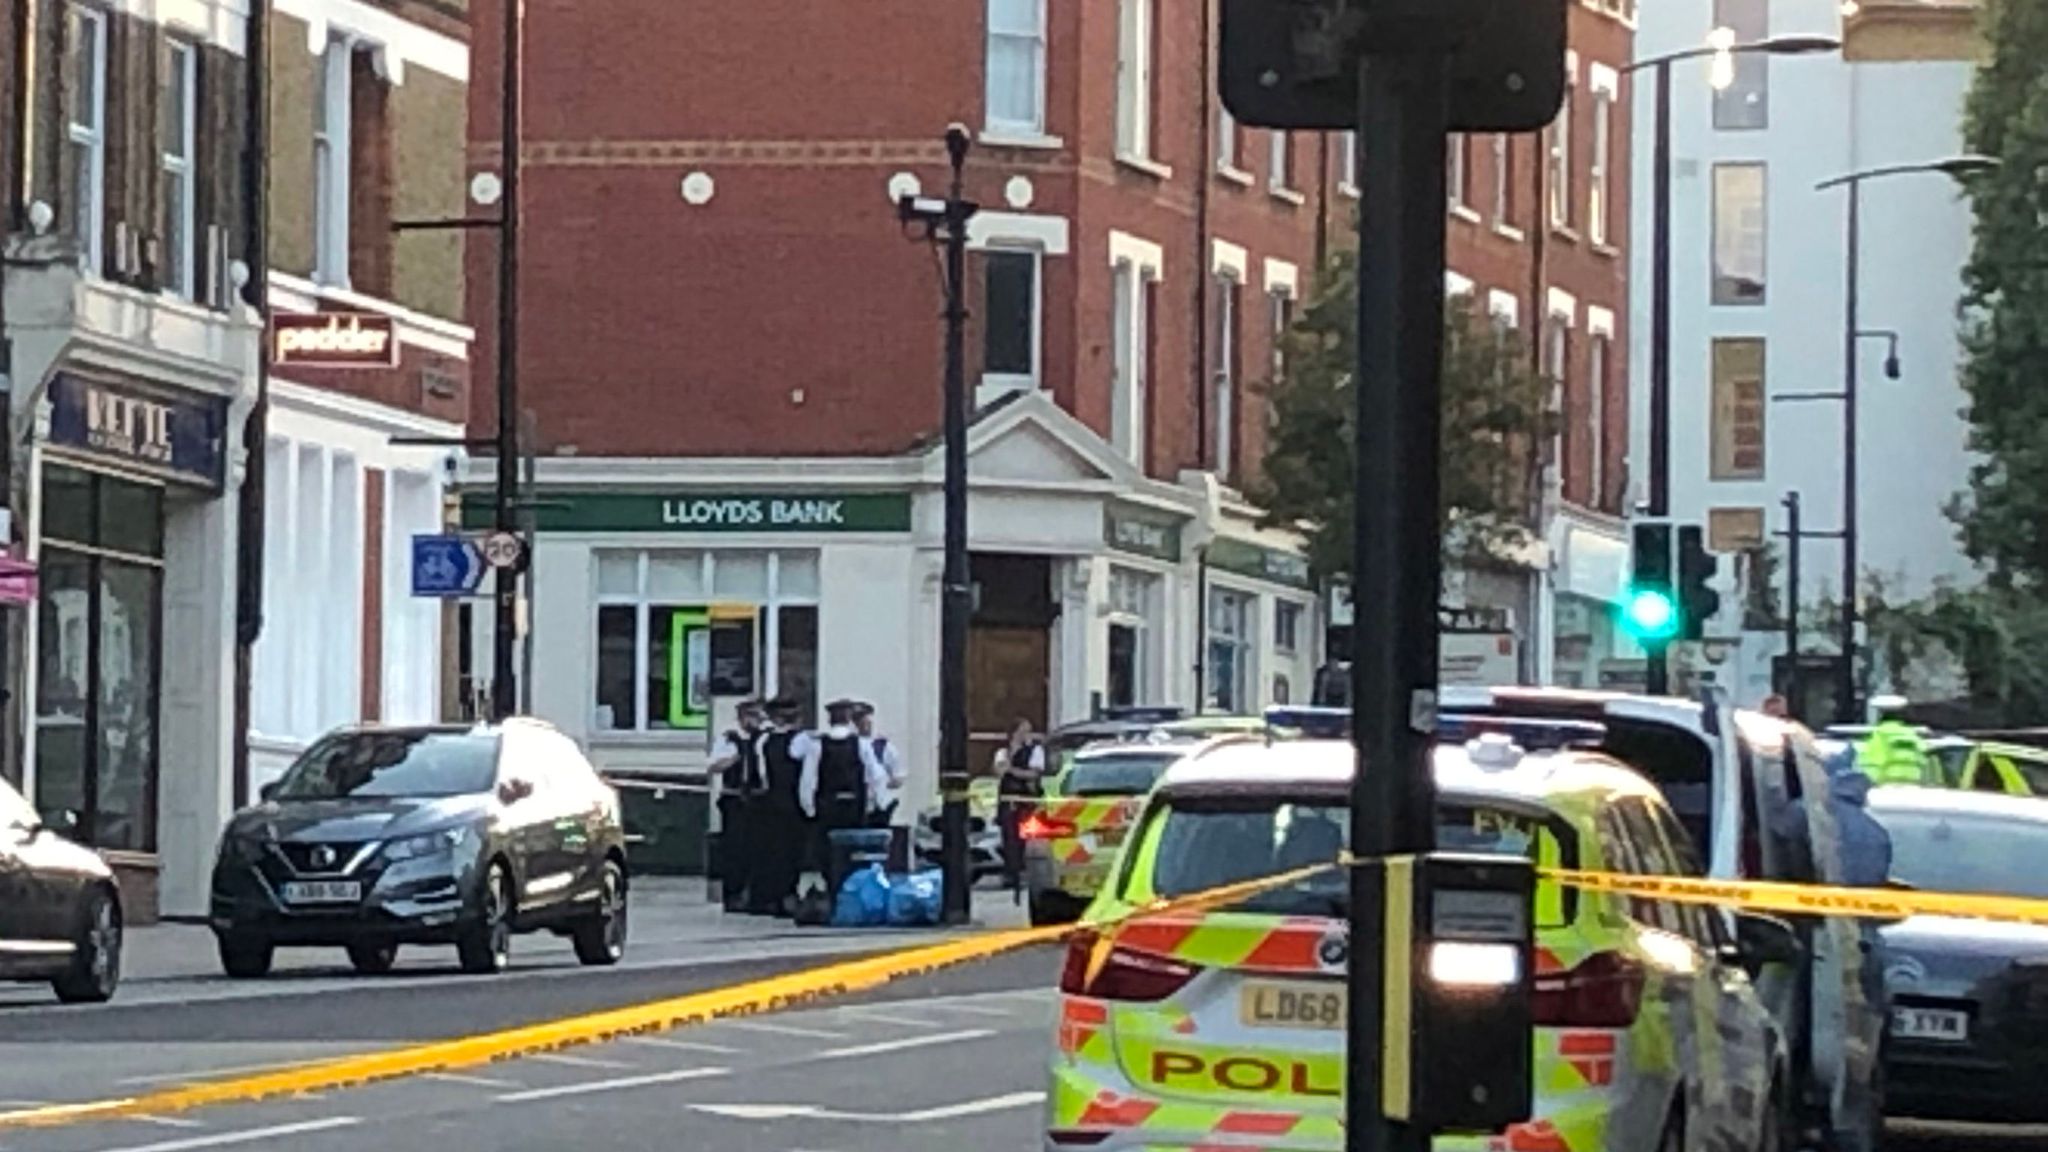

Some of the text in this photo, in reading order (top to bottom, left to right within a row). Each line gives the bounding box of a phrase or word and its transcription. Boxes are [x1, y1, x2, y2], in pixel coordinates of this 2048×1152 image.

[663, 500, 844, 523] LLOYDS BANK
[486, 540, 517, 558] 20
[1253, 989, 1341, 1024] LD68
